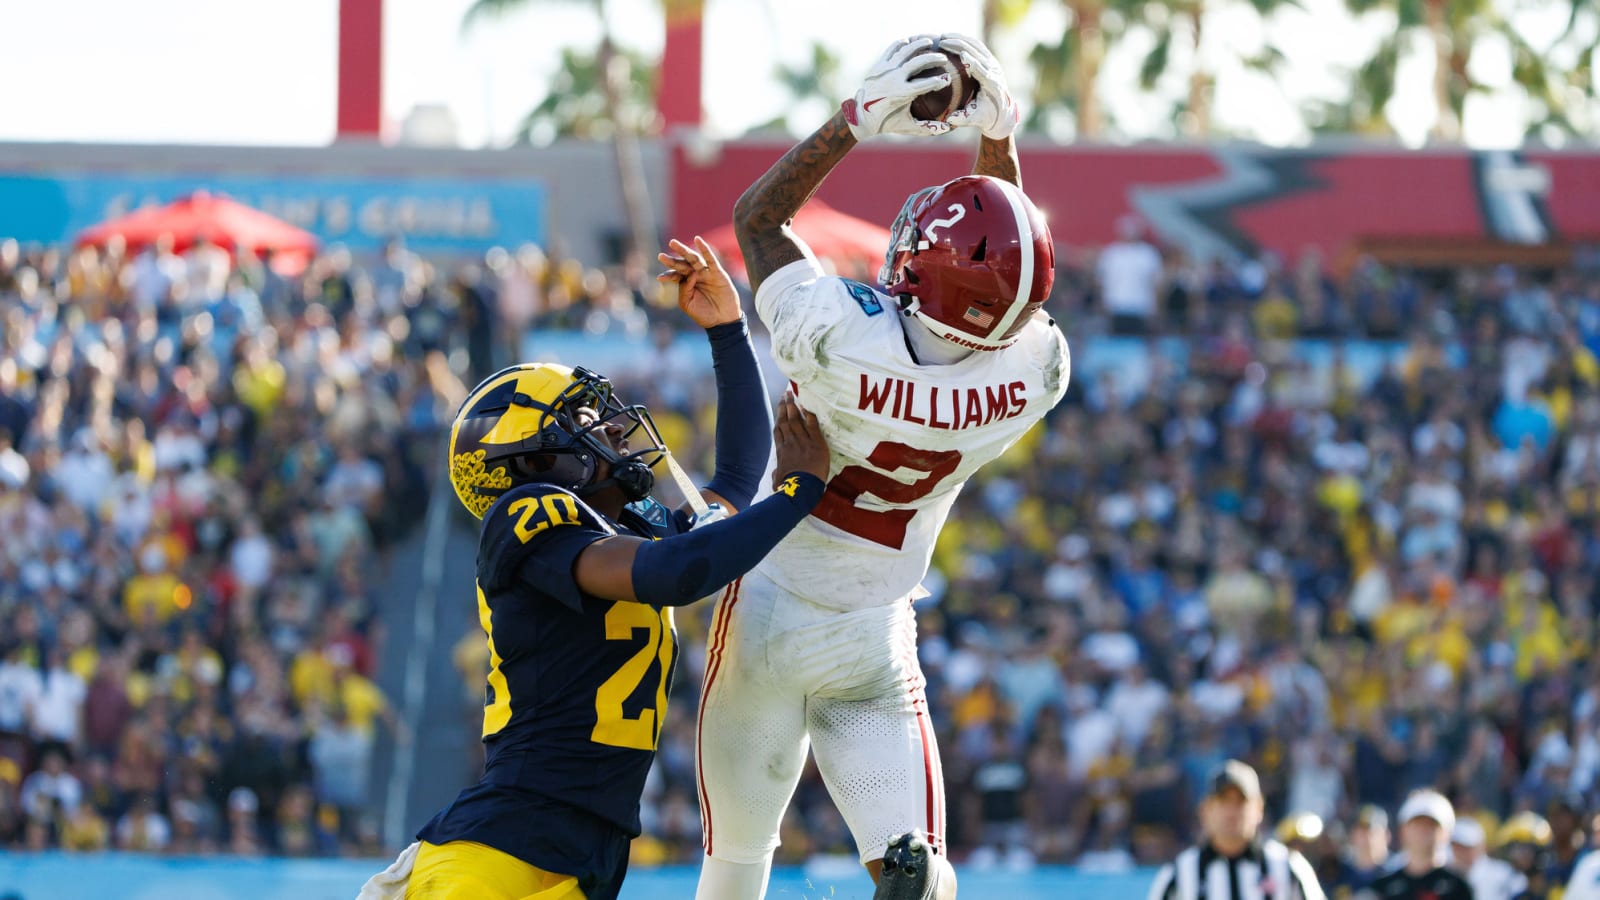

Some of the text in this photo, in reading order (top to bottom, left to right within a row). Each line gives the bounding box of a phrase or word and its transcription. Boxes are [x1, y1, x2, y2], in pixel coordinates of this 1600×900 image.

[924, 203, 966, 244] 2
[857, 373, 1028, 431] WILLIAMS
[508, 493, 582, 545] 20
[809, 440, 963, 552] 2
